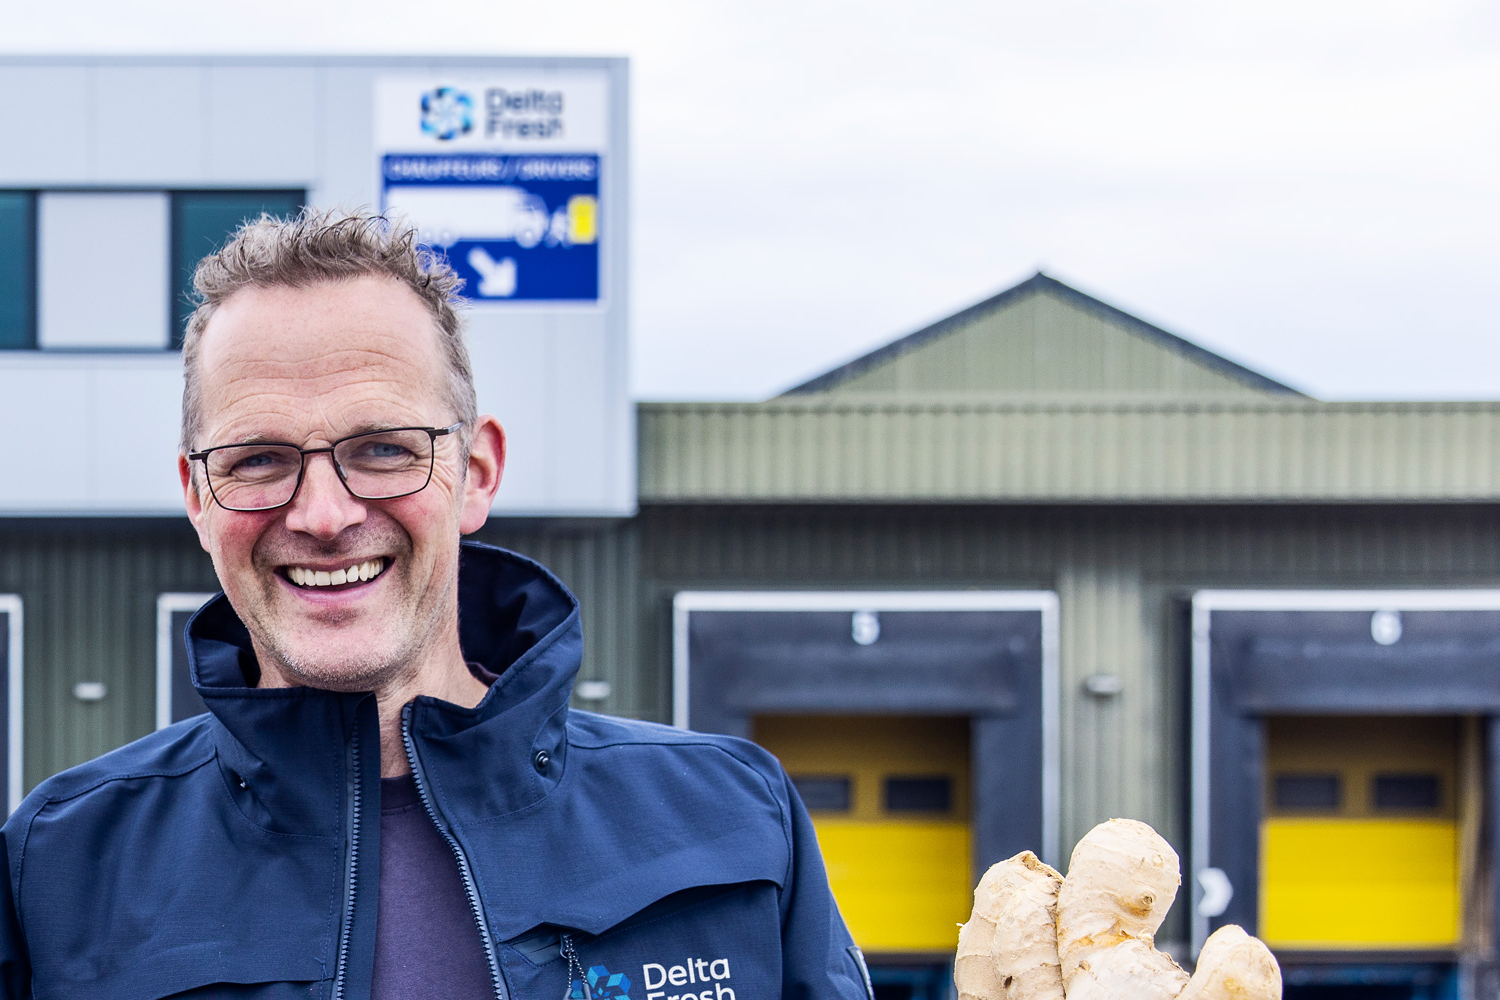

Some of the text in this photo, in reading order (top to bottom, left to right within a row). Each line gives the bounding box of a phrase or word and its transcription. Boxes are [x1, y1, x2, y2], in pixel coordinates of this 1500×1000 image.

[484, 87, 563, 114] Delta
[484, 114, 563, 139] Fresh
[642, 957, 731, 990] Delta
